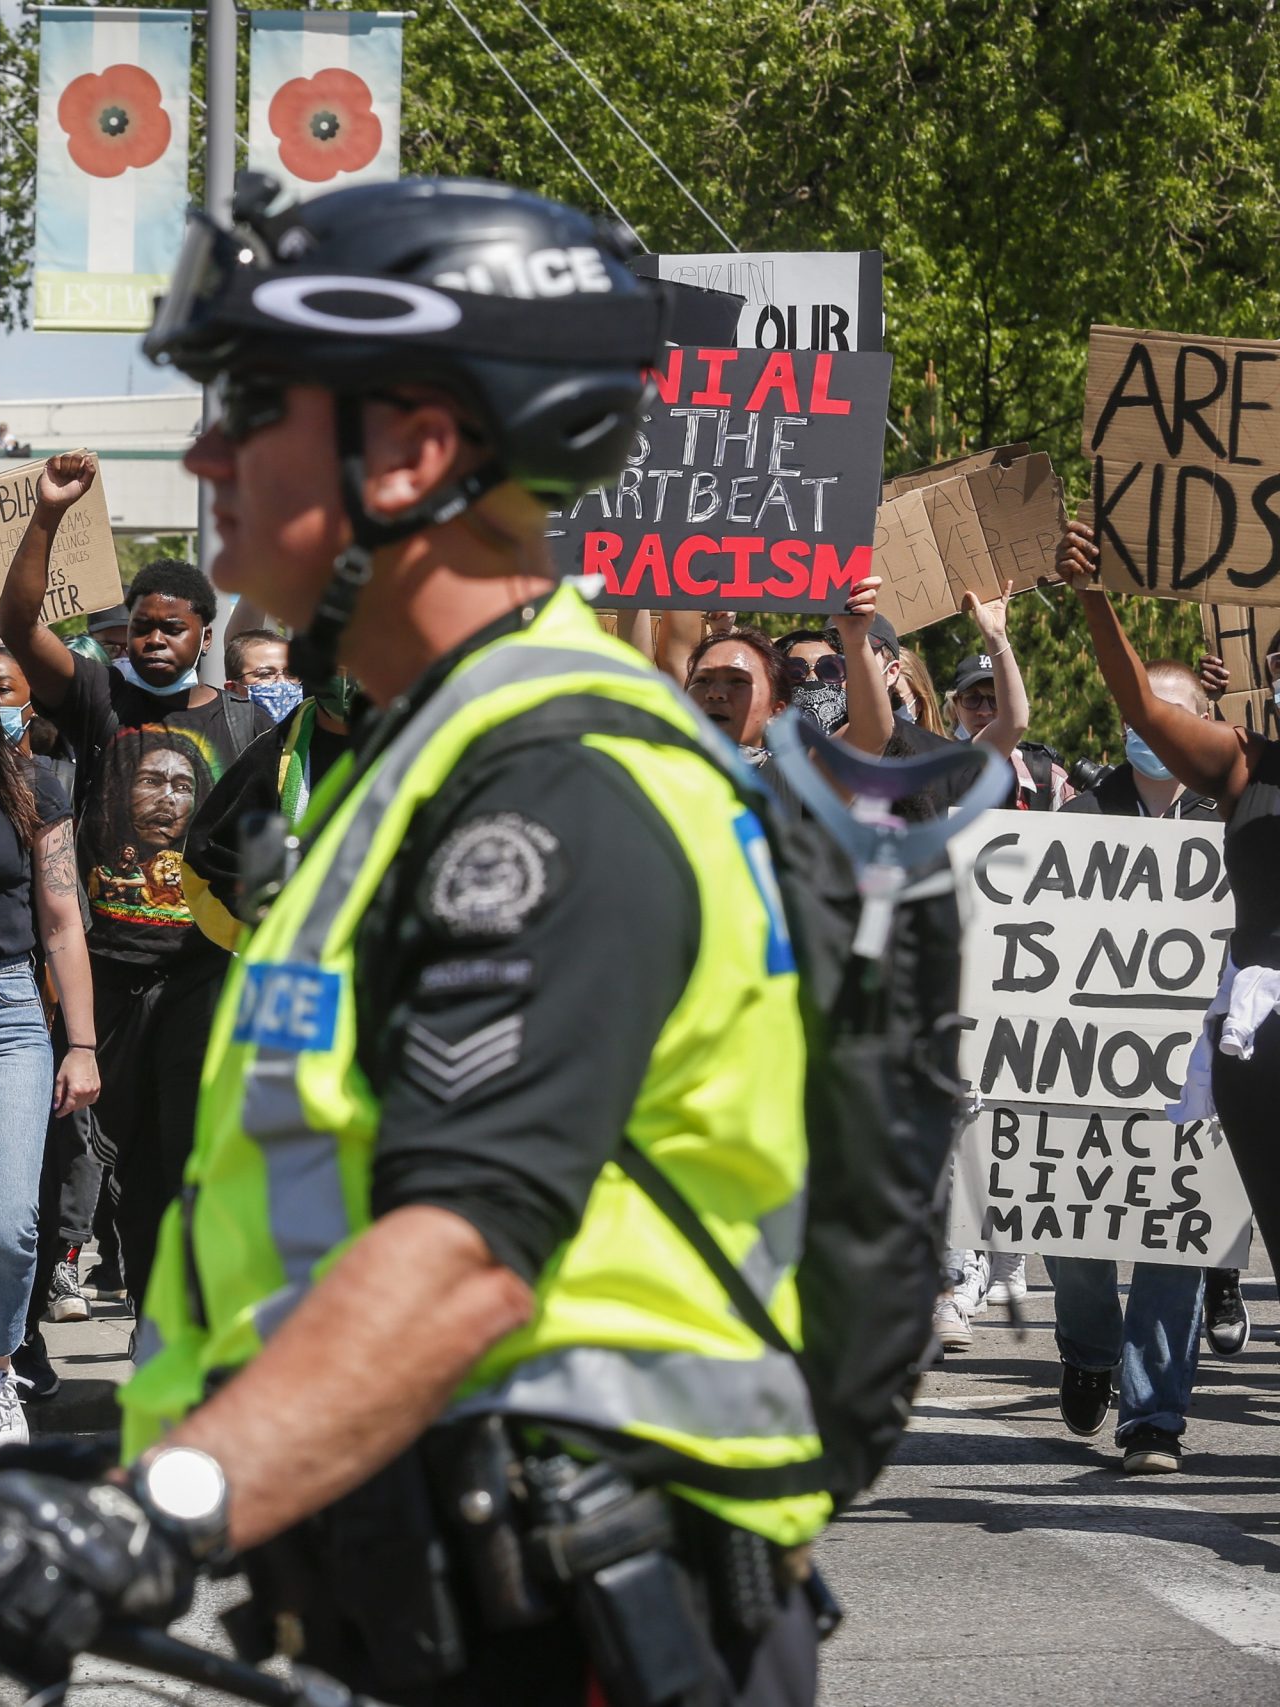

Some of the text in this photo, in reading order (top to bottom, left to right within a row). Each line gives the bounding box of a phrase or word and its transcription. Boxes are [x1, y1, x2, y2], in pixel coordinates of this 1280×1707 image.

[753, 304, 850, 351] OUR
[640, 349, 851, 415] NIAL
[1091, 342, 1278, 465] ARE
[670, 408, 807, 477] THE
[550, 467, 838, 532] ARTBEAT
[1093, 455, 1280, 589] KIDS
[583, 531, 873, 600] RACISM
[882, 514, 1001, 583] LIVES
[895, 533, 1057, 619] MATTER
[979, 655, 993, 669] LA
[992, 921, 1060, 992] IS
[960, 1013, 1192, 1100] NNOC
[991, 1108, 1205, 1162] BLACK
[988, 1162, 1203, 1213] LIVES
[981, 1204, 1212, 1254] MATTER
